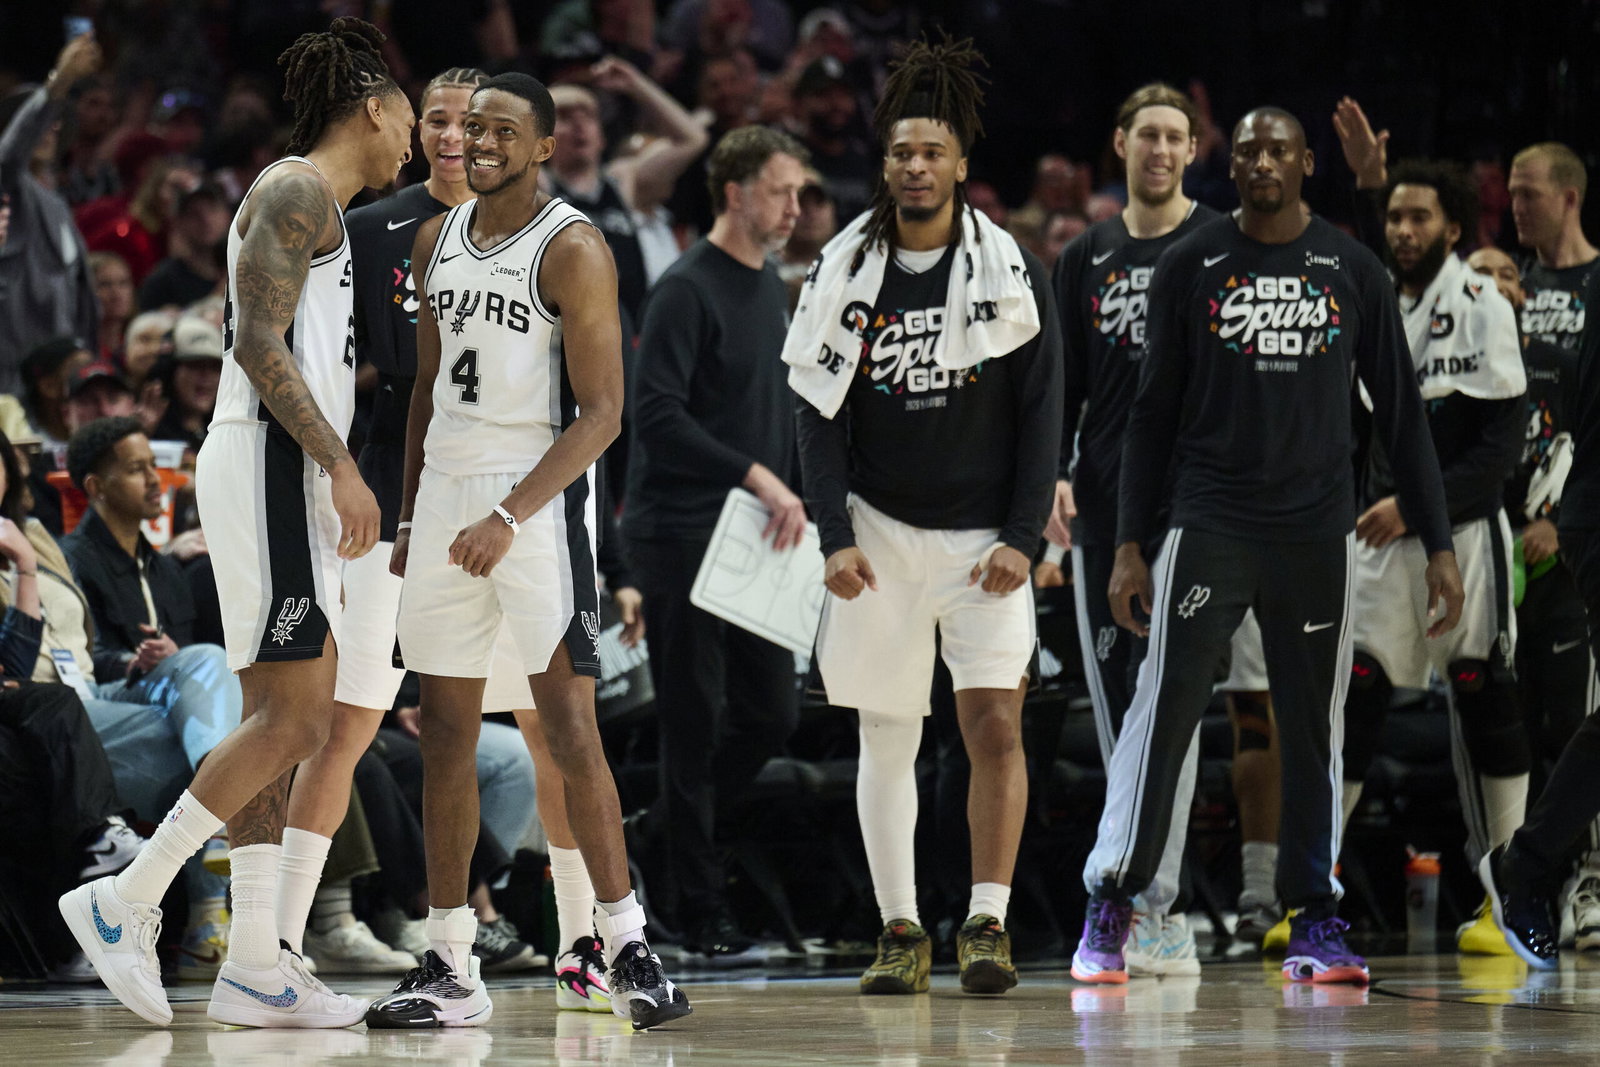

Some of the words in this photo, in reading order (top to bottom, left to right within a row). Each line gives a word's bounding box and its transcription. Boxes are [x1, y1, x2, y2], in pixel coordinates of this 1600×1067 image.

[495, 266, 521, 277] LEDGER
[1256, 276, 1302, 300] GO
[1218, 285, 1328, 344] Spurs
[1257, 330, 1302, 356] GO
[450, 347, 481, 405] 4
[906, 368, 950, 392] GO
